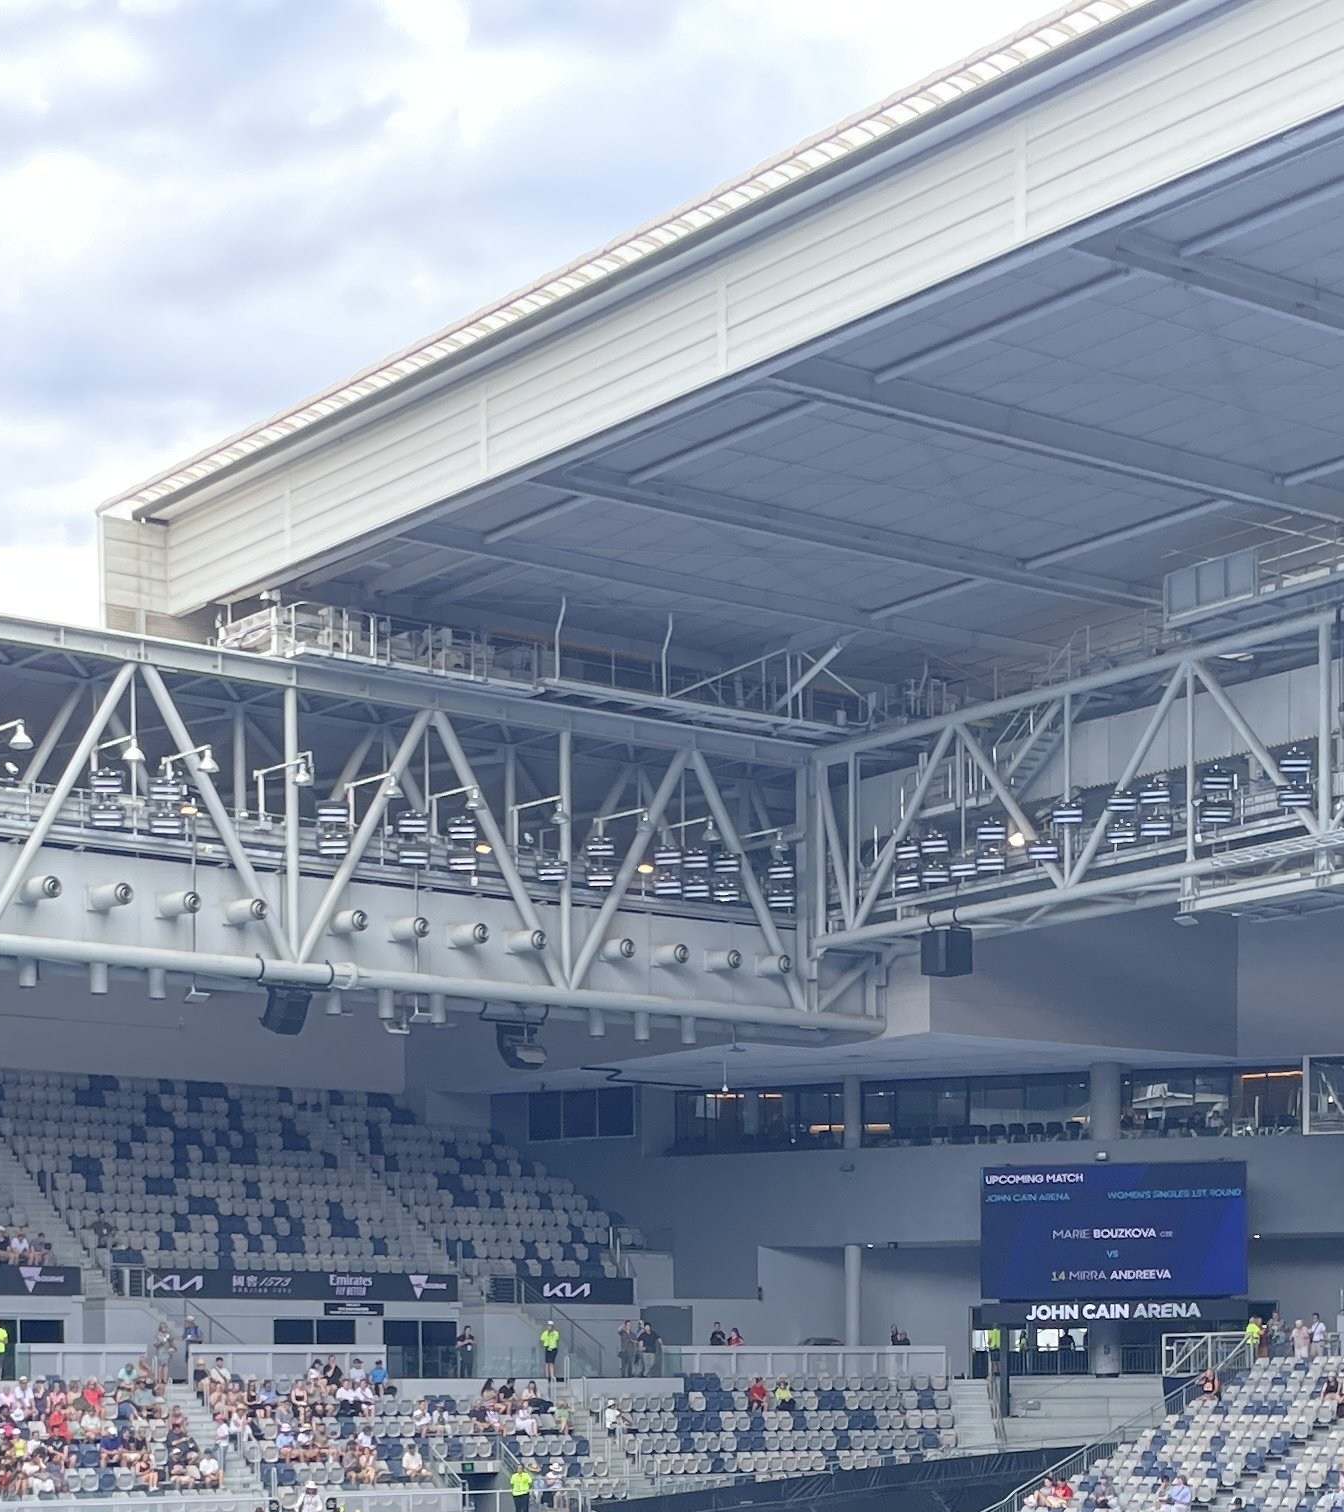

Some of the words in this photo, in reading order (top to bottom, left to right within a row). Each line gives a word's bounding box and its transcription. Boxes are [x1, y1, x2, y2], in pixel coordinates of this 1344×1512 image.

[985, 1174, 1043, 1185] UPCOMING
[1046, 1173, 1084, 1183] MATCH
[985, 1194, 1011, 1202] JOHN
[1013, 1193, 1037, 1201] CAIN
[1038, 1192, 1070, 1201] ARENA
[1209, 1188, 1242, 1197] ROUND
[1052, 1229, 1091, 1239] MARIE
[1093, 1228, 1157, 1239] BOUZKOVA
[1106, 1250, 1119, 1258] VS
[329, 1274, 373, 1286] Emirates
[1051, 1271, 1066, 1281] 14
[1068, 1270, 1107, 1280] MIRRA
[1110, 1269, 1172, 1280] ANDREEVA
[1025, 1304, 1078, 1320] JOHN
[1082, 1303, 1129, 1319] CAIN
[1133, 1303, 1202, 1318] ARENA
